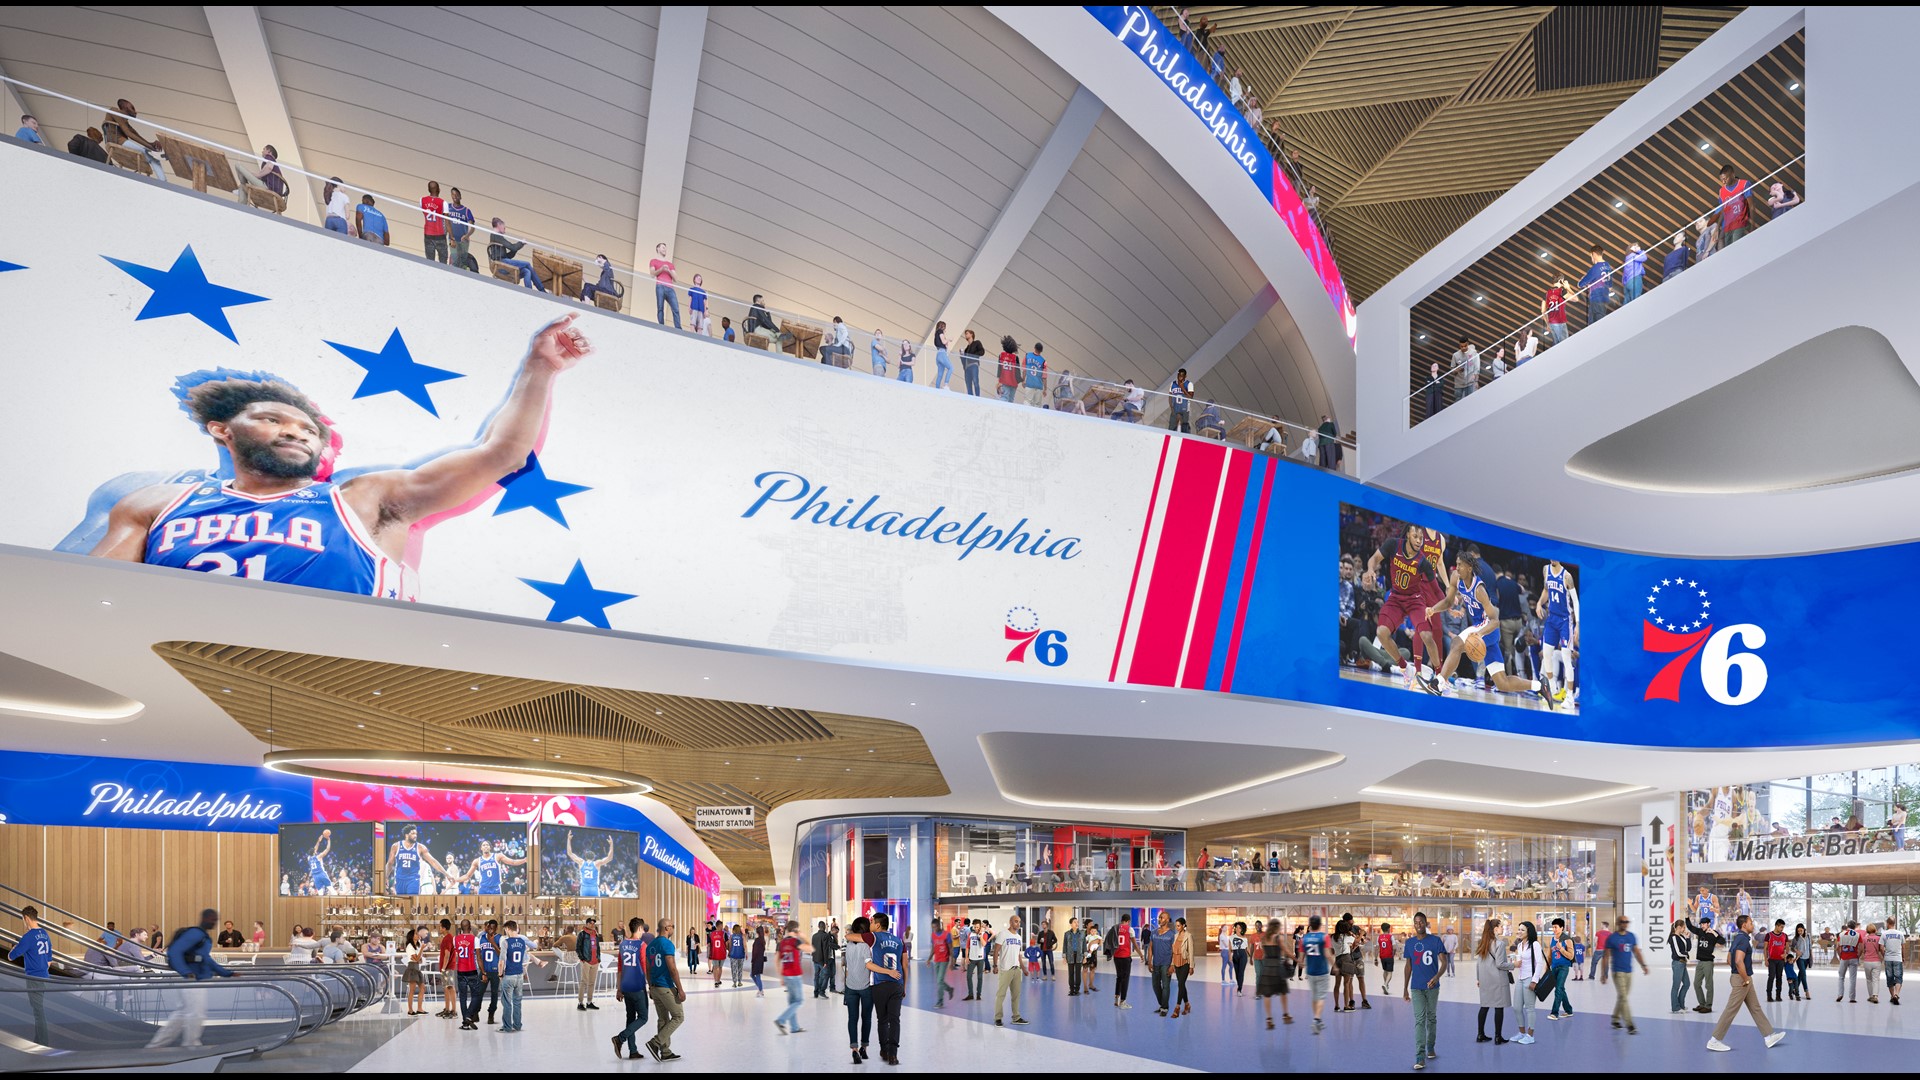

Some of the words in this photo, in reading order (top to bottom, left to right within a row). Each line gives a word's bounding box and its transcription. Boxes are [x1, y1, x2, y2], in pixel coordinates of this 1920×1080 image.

[1117, 5, 1257, 174] Philadelphia
[426, 209, 437, 222] 21
[1733, 205, 1741, 214] 21
[741, 471, 1083, 561] Philadelphia
[158, 511, 325, 553] PHILA
[1395, 570, 1410, 590] 10
[1551, 591, 1560, 603] 14
[1005, 625, 1068, 667] 76
[1643, 618, 1768, 706] 76
[83, 782, 282, 826] Philadelphia
[697, 808, 744, 816] CHINATOWN
[1735, 835, 1814, 861] Market
[1825, 834, 1869, 856] Bar
[643, 836, 690, 876] Philadelphia
[402, 860, 411, 868] 21
[584, 869, 593, 879] 21
[1649, 849, 1664, 909] STREET
[1649, 915, 1664, 952] 10TH
[36, 941, 49, 955] 21
[715, 940, 721, 948] 0
[733, 939, 741, 947] 21
[880, 940, 899, 949] MAXEY
[1305, 943, 1320, 956] 21
[1699, 940, 1709, 948] 76
[458, 946, 469, 958] 21
[485, 950, 494, 962] 0
[513, 951, 522, 963] 0
[1413, 950, 1433, 966] 76
[623, 952, 637, 967] 21
[884, 953, 897, 970] 0
